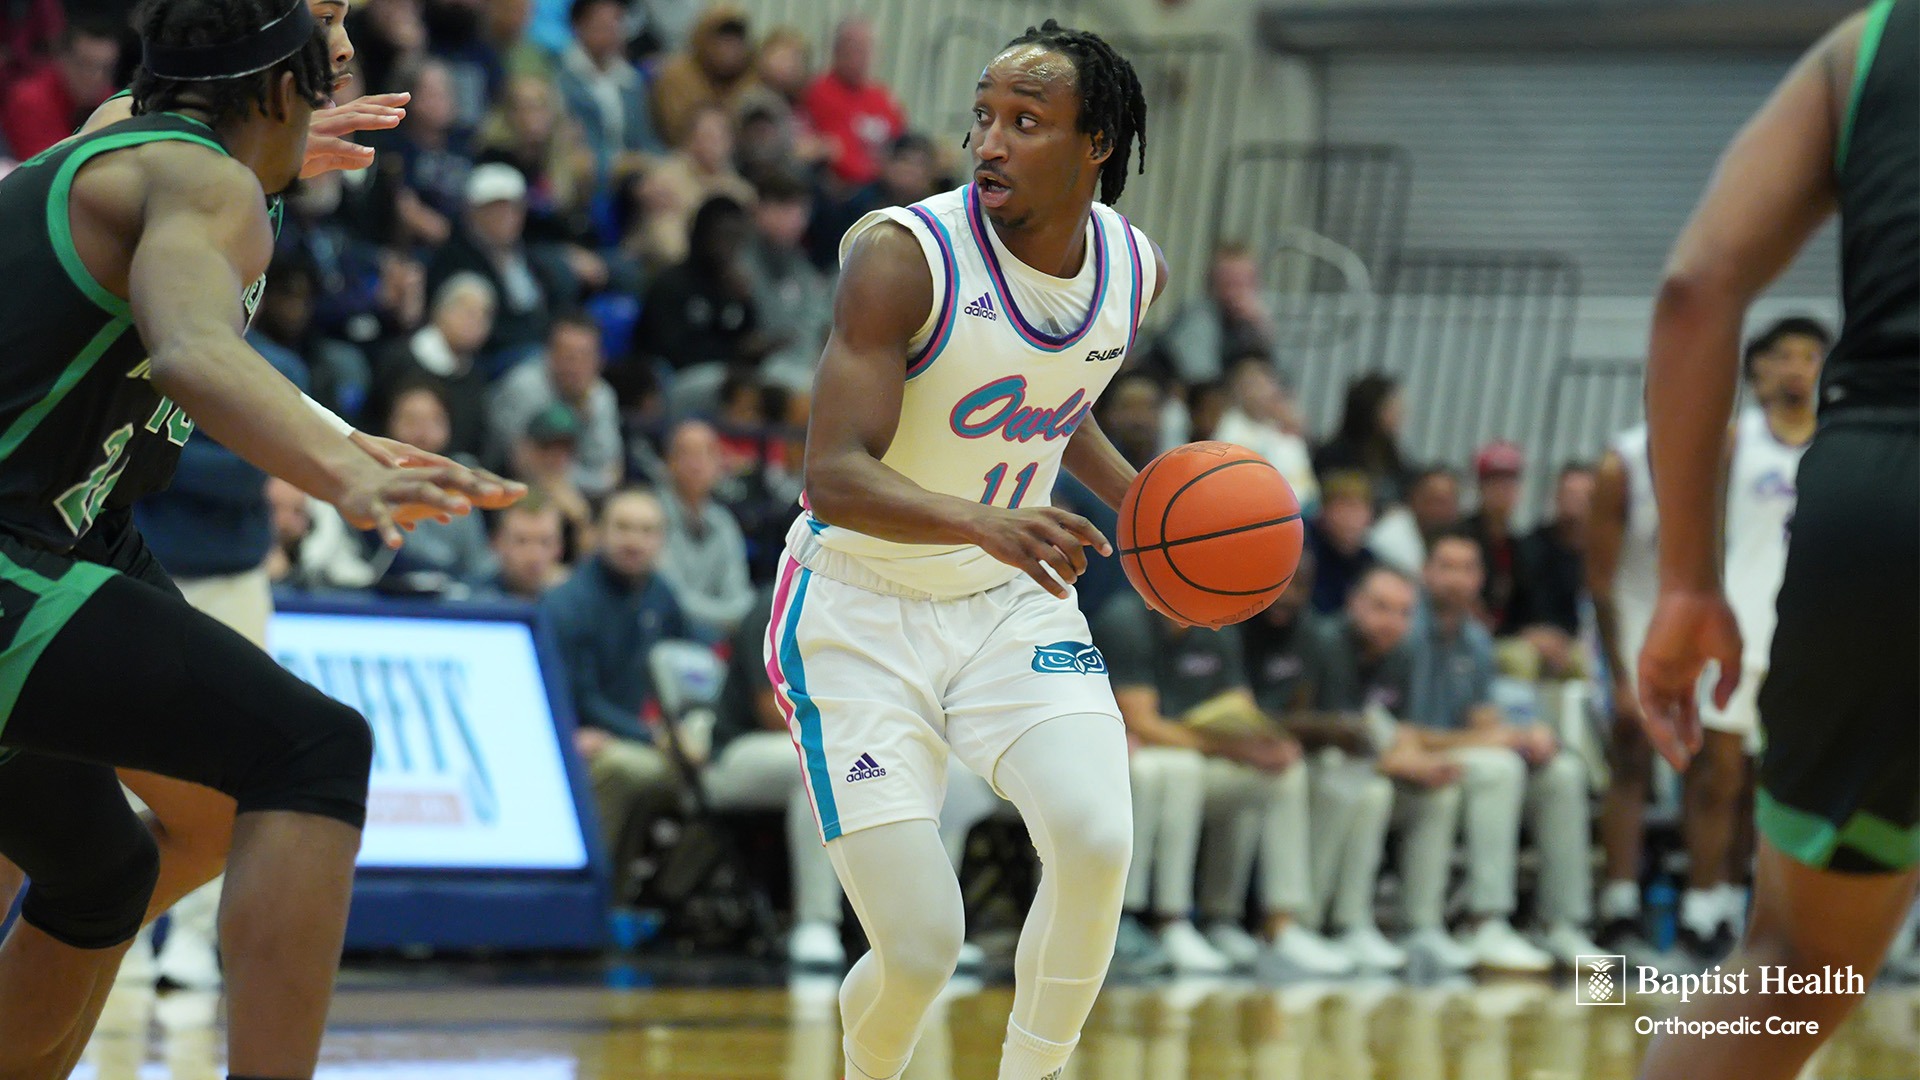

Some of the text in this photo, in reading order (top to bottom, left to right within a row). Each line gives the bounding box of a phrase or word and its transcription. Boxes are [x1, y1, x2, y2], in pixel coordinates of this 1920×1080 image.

[964, 304, 997, 321] adidas
[950, 374, 1092, 443] Owls
[980, 459, 1039, 510] 11
[846, 767, 887, 783] adidas
